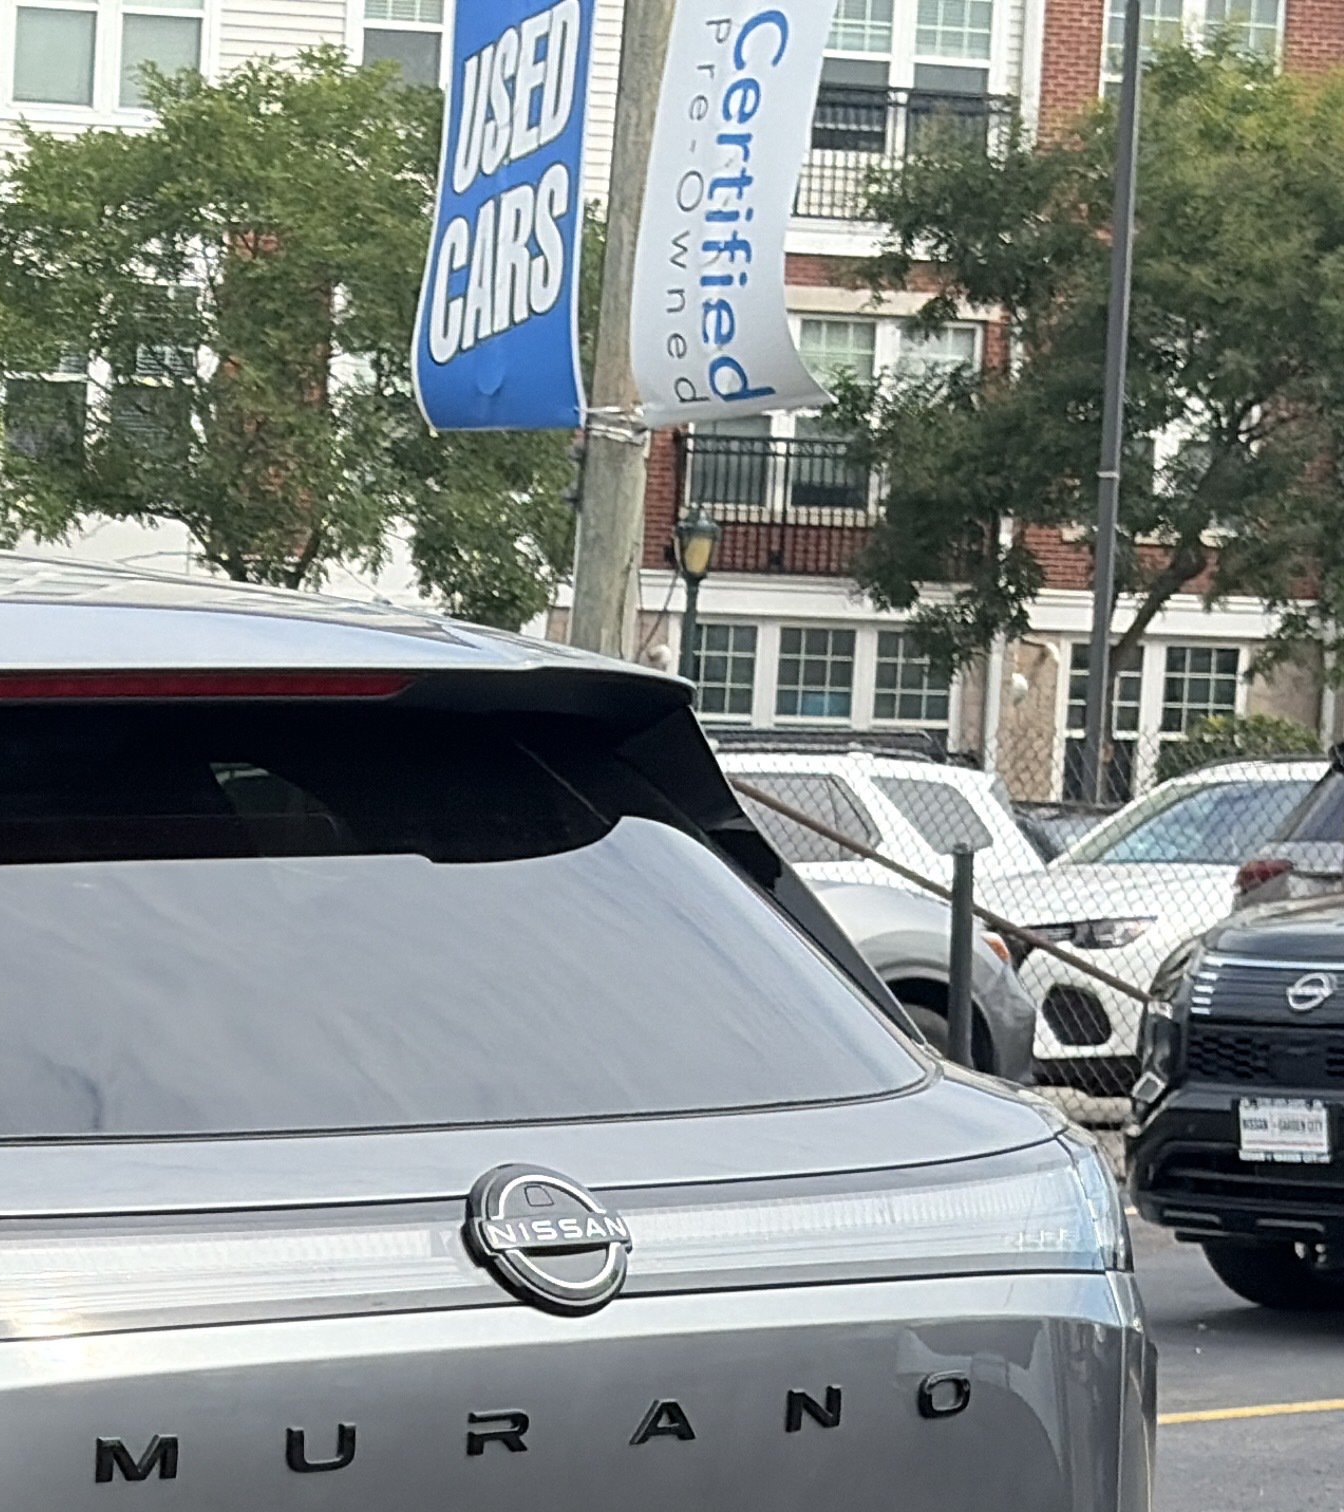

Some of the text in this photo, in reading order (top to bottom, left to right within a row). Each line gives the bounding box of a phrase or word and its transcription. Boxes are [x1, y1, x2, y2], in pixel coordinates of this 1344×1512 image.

[452, 0, 581, 195] USED
[428, 161, 570, 365] CARS
[666, 17, 731, 405] Pre-Owned
[700, 9, 790, 403] Certified
[487, 1214, 629, 1250] NISSAN
[94, 1369, 973, 1484] MURANO
